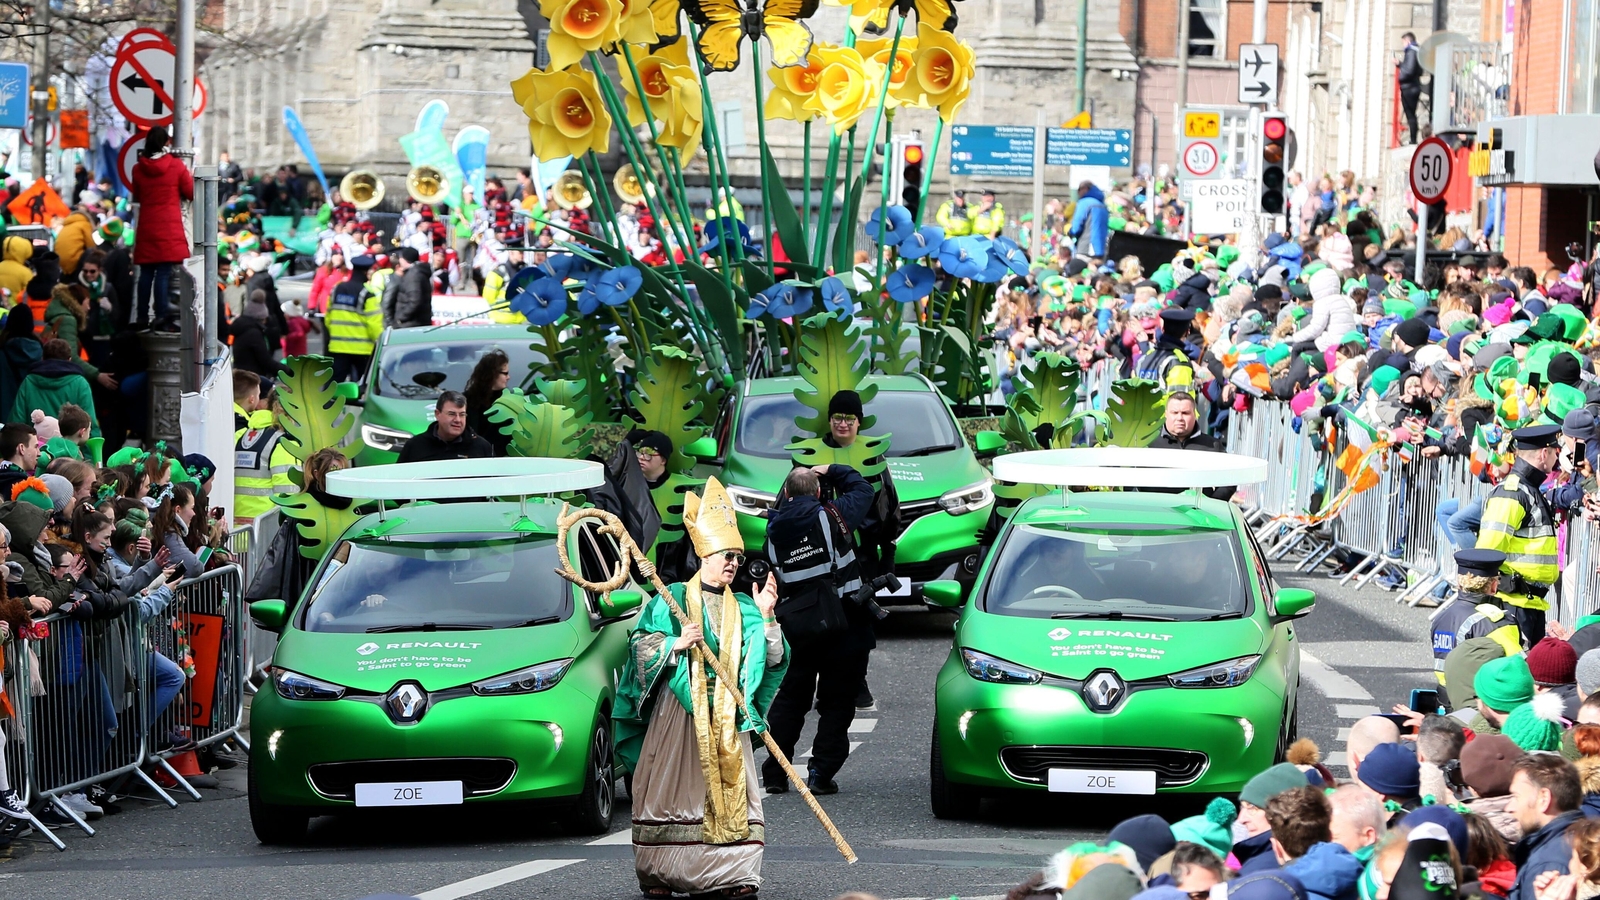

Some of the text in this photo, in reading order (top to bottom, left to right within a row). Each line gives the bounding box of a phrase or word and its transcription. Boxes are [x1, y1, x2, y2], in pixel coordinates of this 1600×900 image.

[1193, 149, 1209, 164] 30
[1421, 154, 1442, 182] 50
[1422, 185, 1439, 195] km/h
[790, 545, 814, 556] OFFICIAL
[1078, 630, 1173, 641] RENAULT
[386, 642, 482, 650] RENAULT
[1105, 643, 1132, 651] have
[1433, 633, 1453, 650] GARDA
[1127, 651, 1161, 660] green
[1087, 775, 1116, 788] ZOE
[393, 787, 423, 800] ZOE
